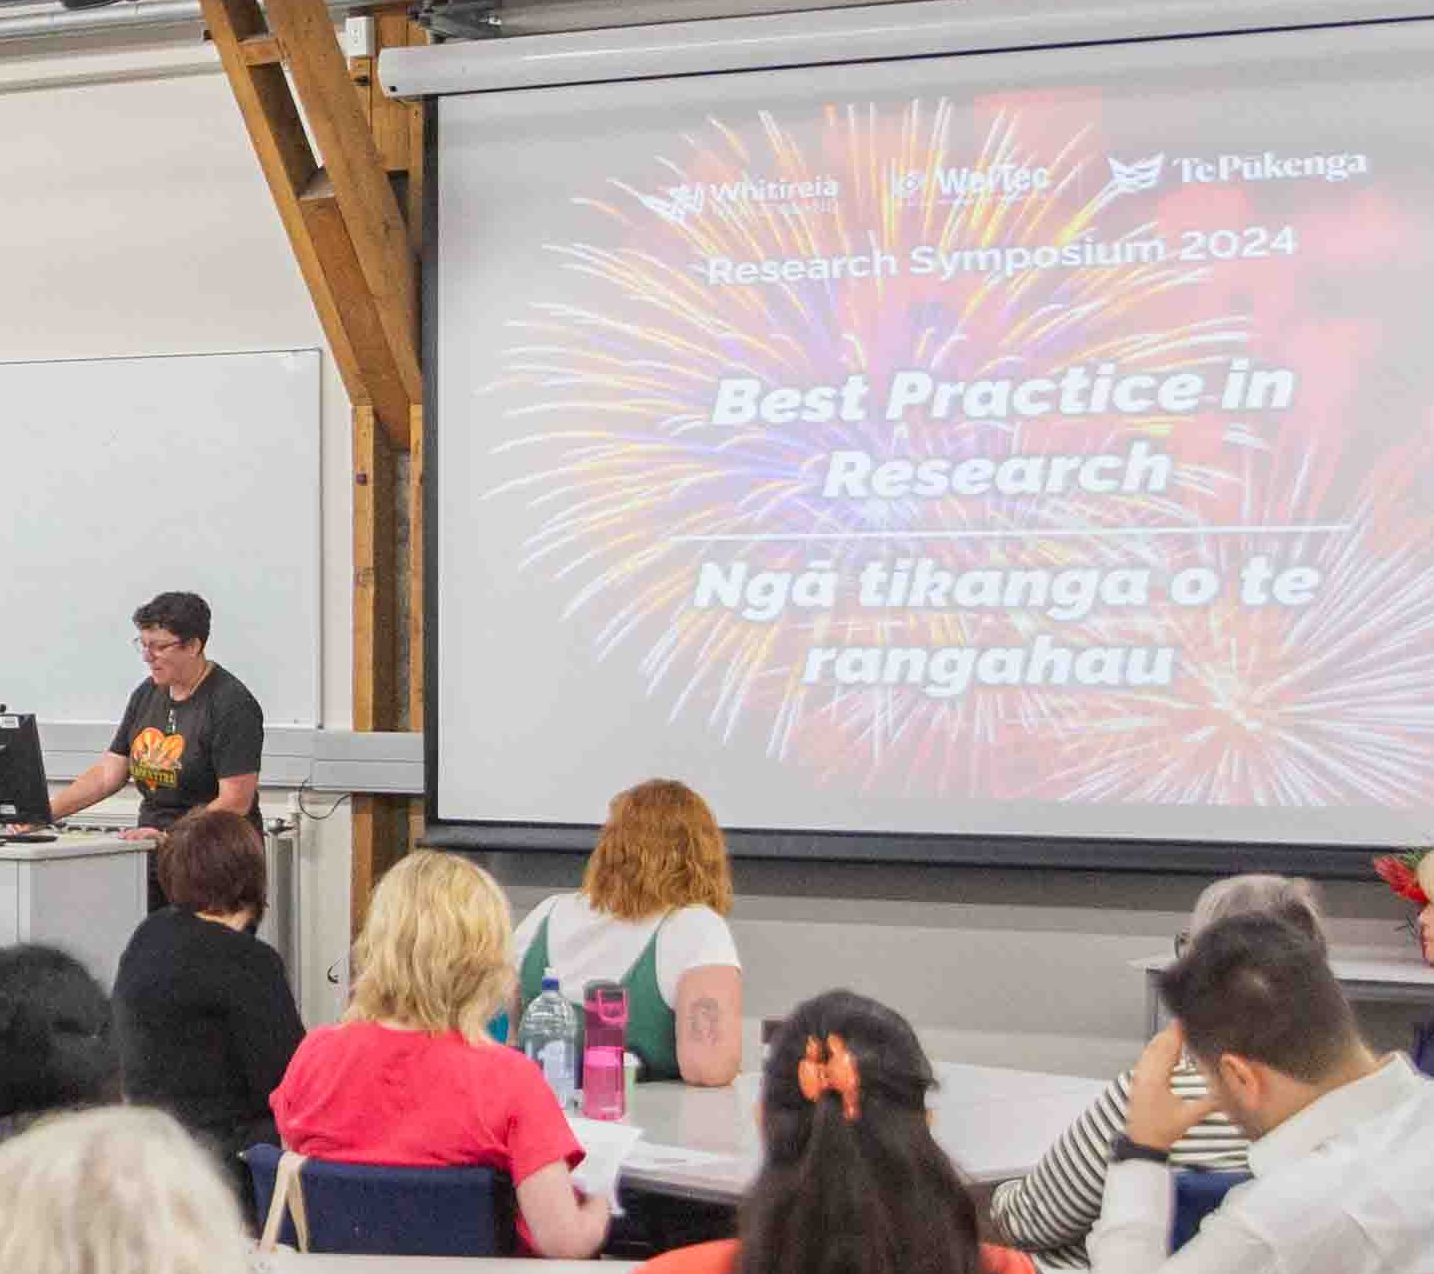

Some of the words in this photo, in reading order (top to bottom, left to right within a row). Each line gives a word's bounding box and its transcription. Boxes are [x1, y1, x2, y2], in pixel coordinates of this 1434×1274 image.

[708, 250, 898, 285] Research
[912, 236, 1166, 277] Symposium
[1179, 225, 1299, 262] 2024
[712, 374, 869, 426] Best
[885, 363, 1204, 420] Practice
[1221, 357, 1295, 410] in
[822, 440, 1174, 499] Research
[694, 561, 836, 620] Ngā
[858, 558, 1152, 620] tikanga
[1171, 567, 1220, 606] o
[1241, 557, 1321, 606] te
[800, 636, 1177, 697] rangahau
